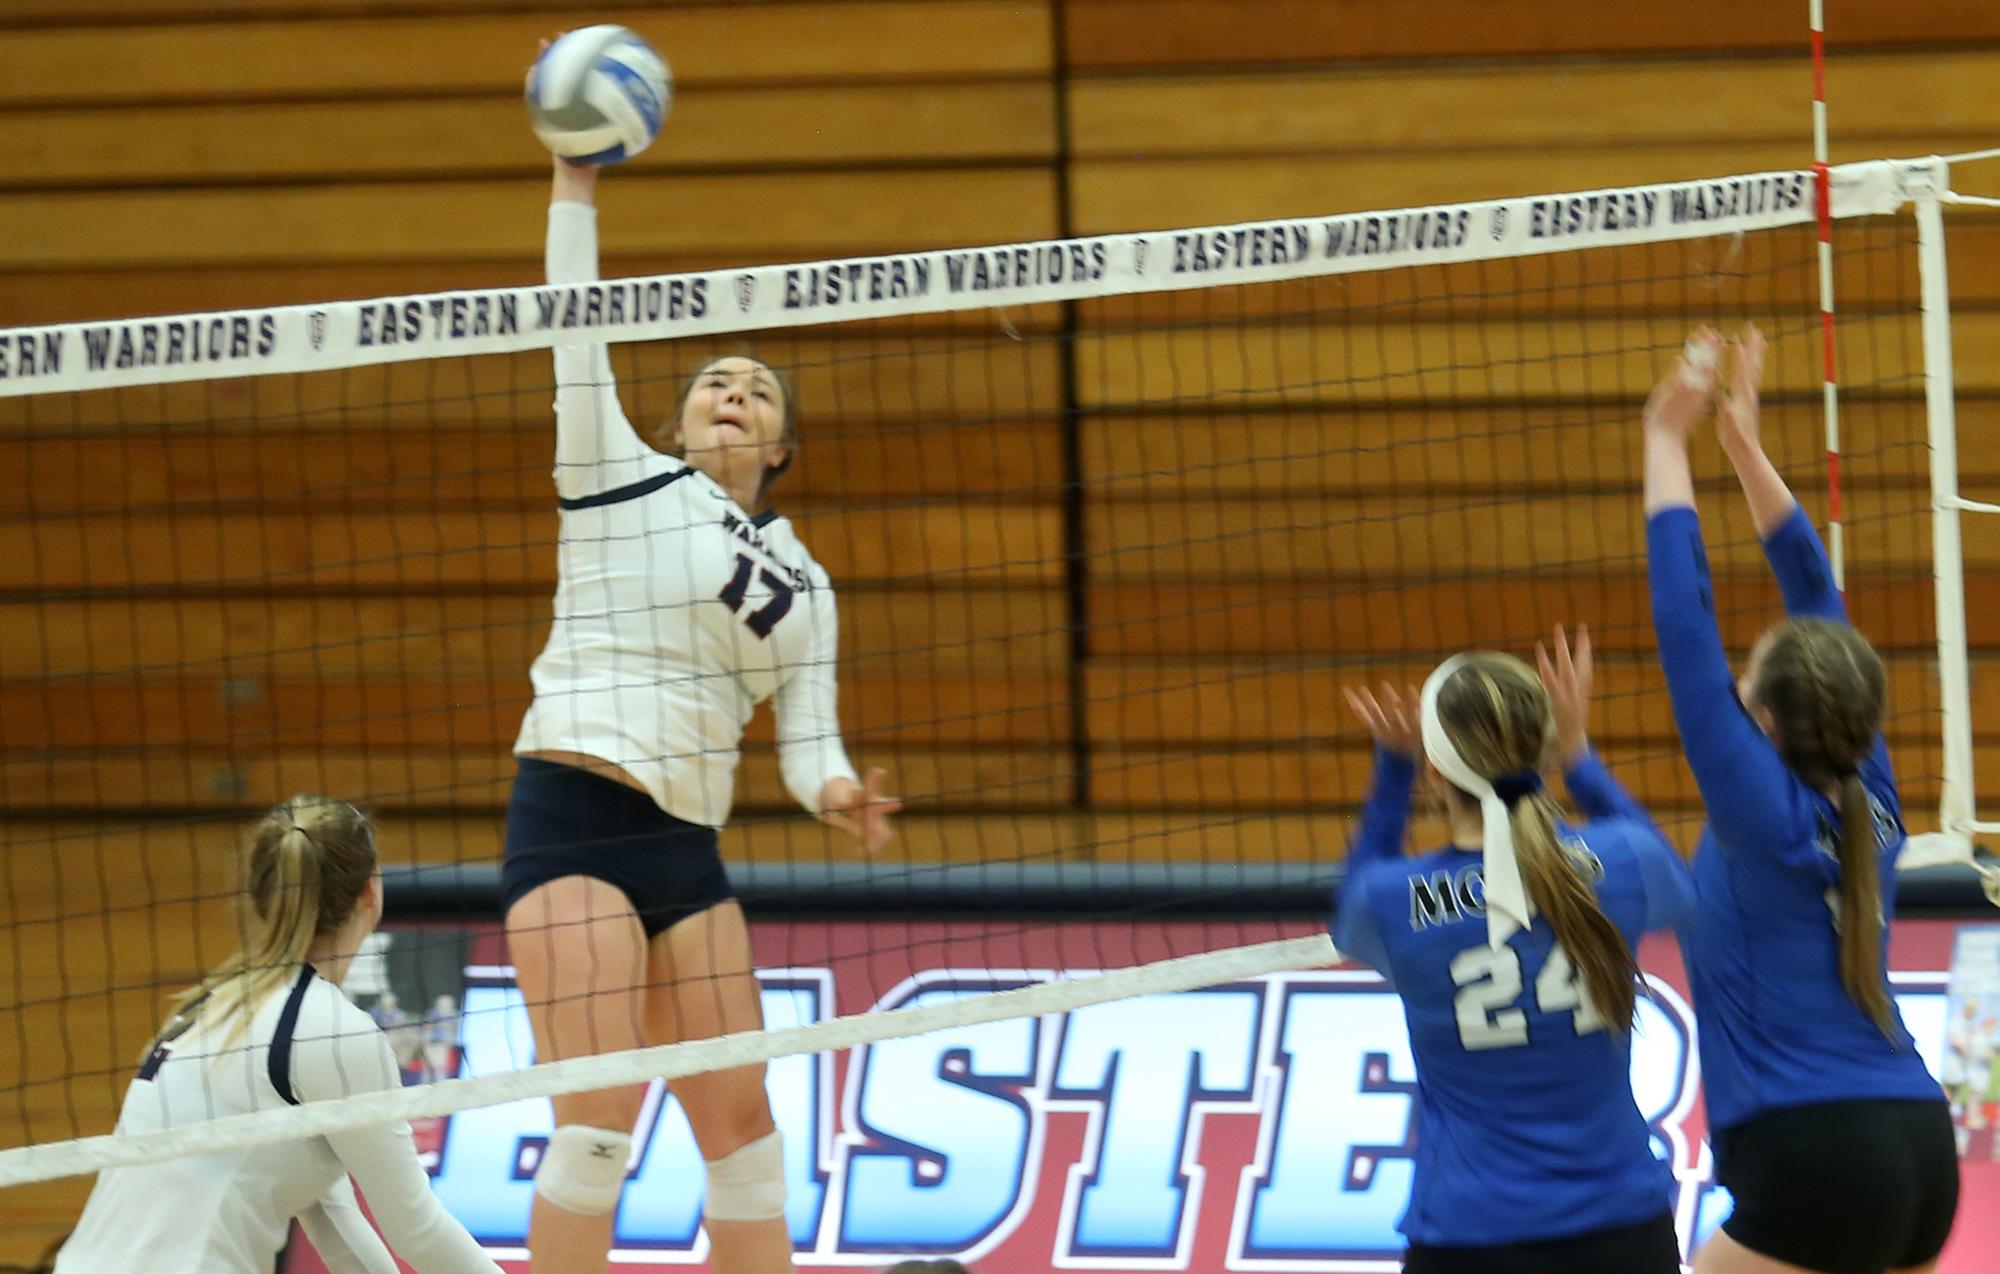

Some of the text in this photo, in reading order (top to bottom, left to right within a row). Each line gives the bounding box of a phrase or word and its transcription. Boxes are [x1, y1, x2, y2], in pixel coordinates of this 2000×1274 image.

[83, 315, 275, 371] WARRIORS
[358, 293, 520, 346] EASTERN
[535, 278, 708, 331] WARRIORS
[784, 256, 930, 309] EASTERN
[943, 241, 1107, 295] WARRIORS
[1173, 224, 1310, 273] EASTERN
[1323, 210, 1470, 259] WARRIORS
[1531, 191, 1657, 238] EASTERN
[1669, 174, 1804, 224] WARRIORS
[718, 552, 795, 641] 17
[1449, 942, 1606, 1051] 24
